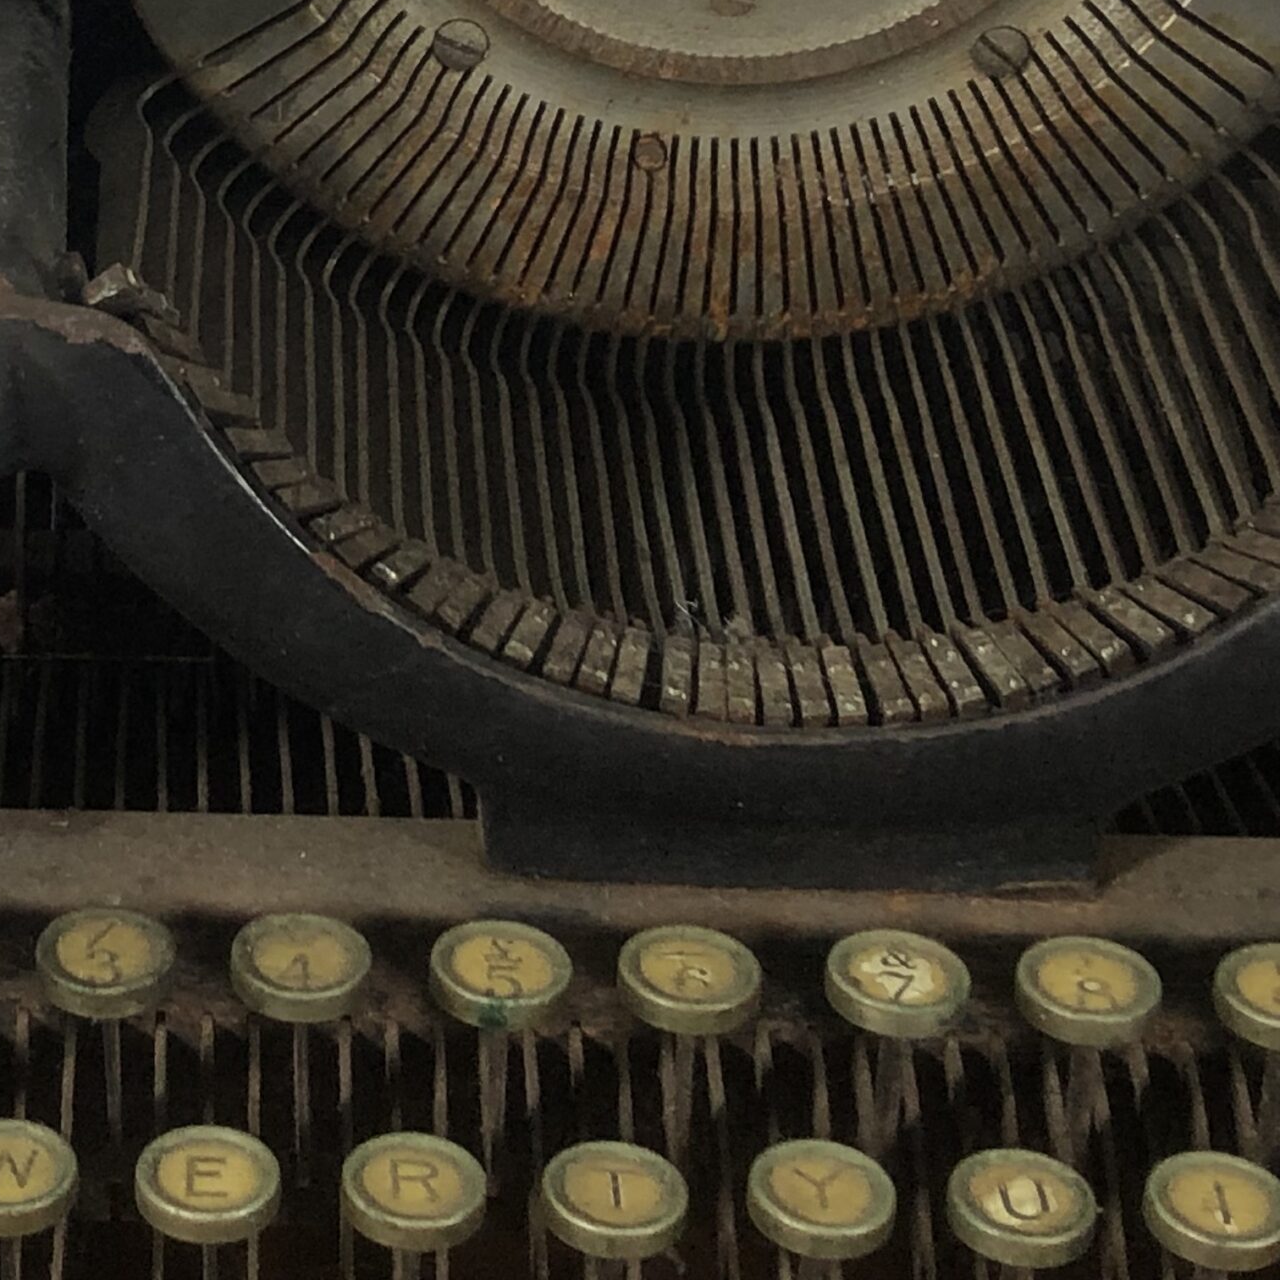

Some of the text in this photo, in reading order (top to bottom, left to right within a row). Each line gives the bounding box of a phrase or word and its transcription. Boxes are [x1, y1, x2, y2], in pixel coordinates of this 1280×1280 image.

[485, 964, 524, 999] 5
[878, 970, 916, 1003] 7
[184, 1154, 229, 1199] E
[388, 1157, 441, 1203] R
[793, 1162, 856, 1211] Y
[998, 1176, 1052, 1221] U
